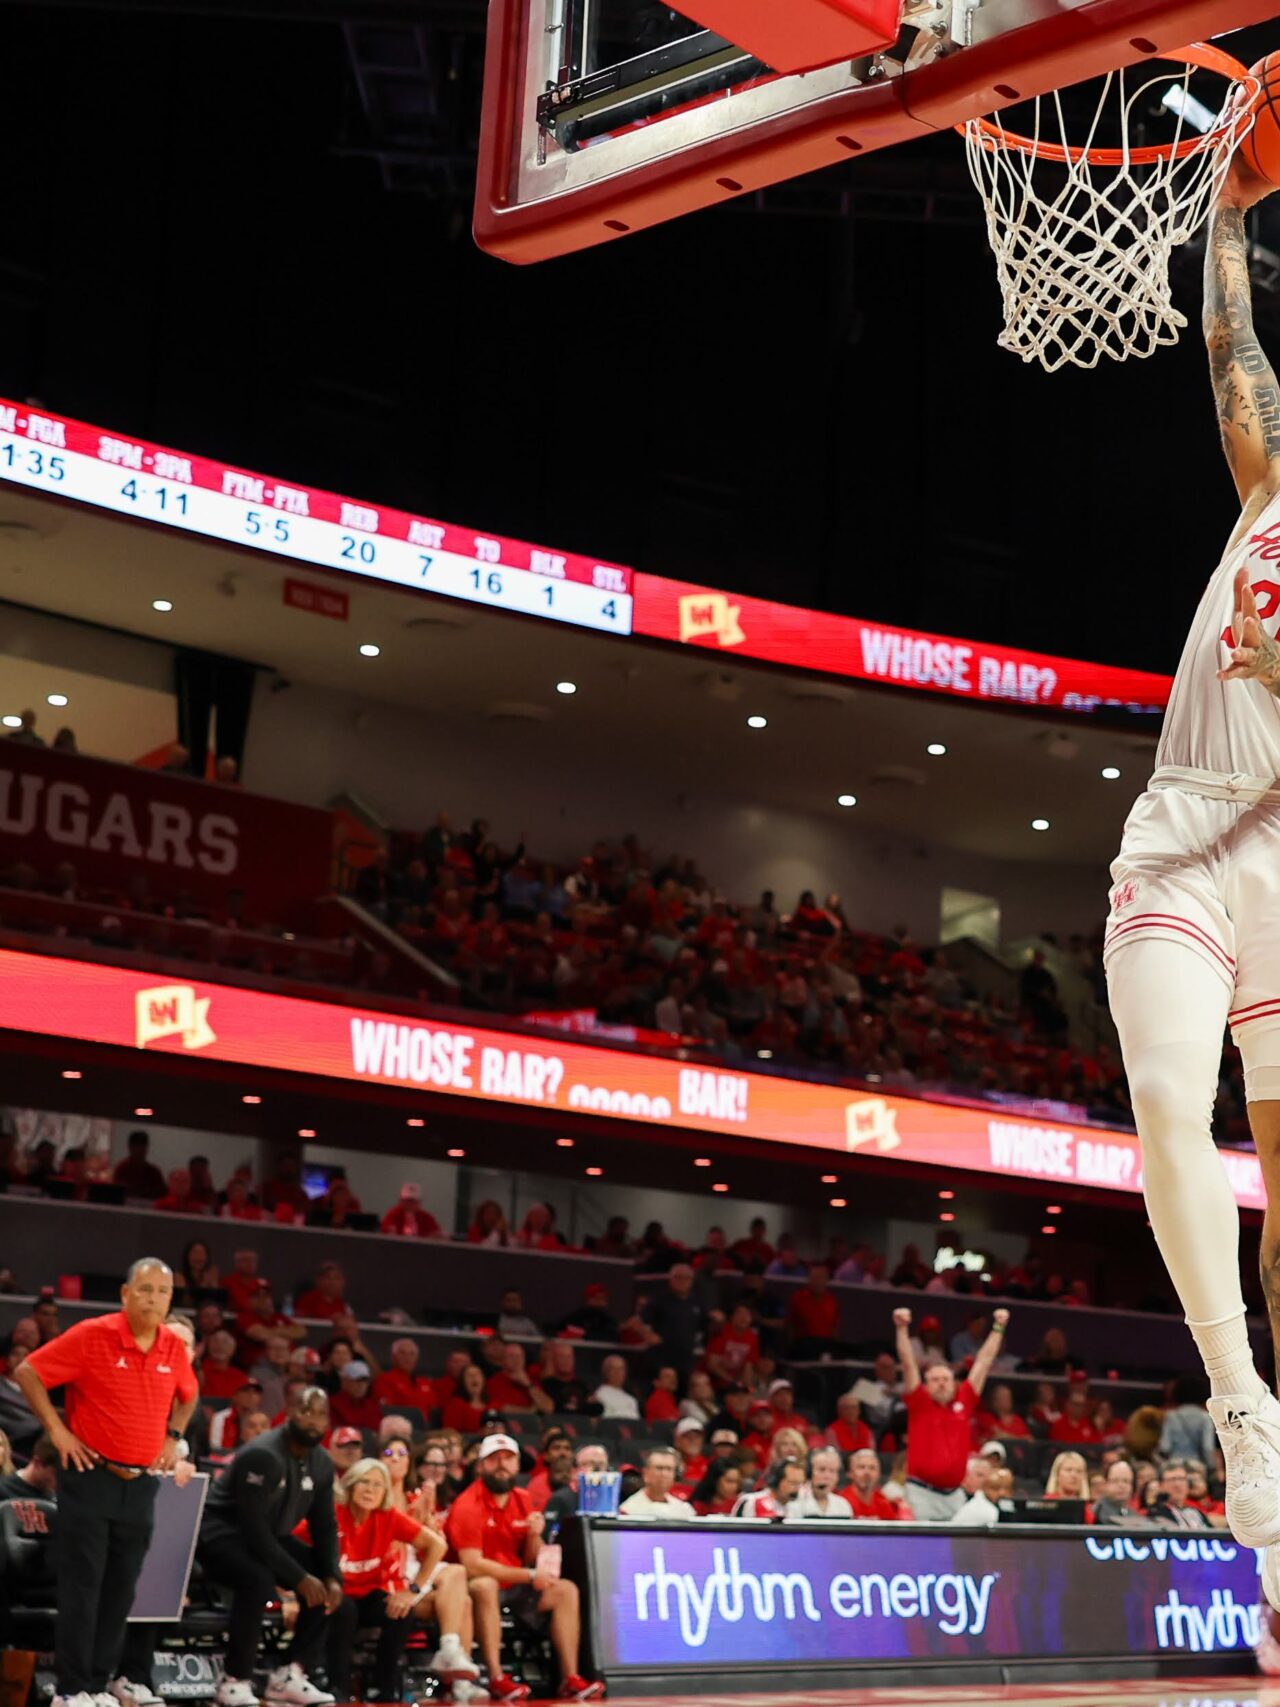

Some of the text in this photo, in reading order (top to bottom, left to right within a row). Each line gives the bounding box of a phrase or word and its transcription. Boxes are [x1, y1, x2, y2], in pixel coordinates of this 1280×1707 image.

[341, 536, 376, 563] 20
[418, 555, 433, 576] 7
[470, 569, 502, 594] 16
[542, 586, 553, 605] 1
[602, 600, 616, 619] 4
[407, 521, 446, 549] AST
[474, 537, 500, 563] TO
[530, 551, 566, 579] BLK
[592, 566, 627, 592] STL
[860, 628, 973, 691] WHOSE
[351, 1018, 474, 1088] WHOSE
[480, 1047, 564, 1103] BAR?
[679, 1069, 749, 1122] BAR!
[988, 1122, 1135, 1184] WHOSE BAR?
[634, 1547, 996, 1647] rhythm energy
